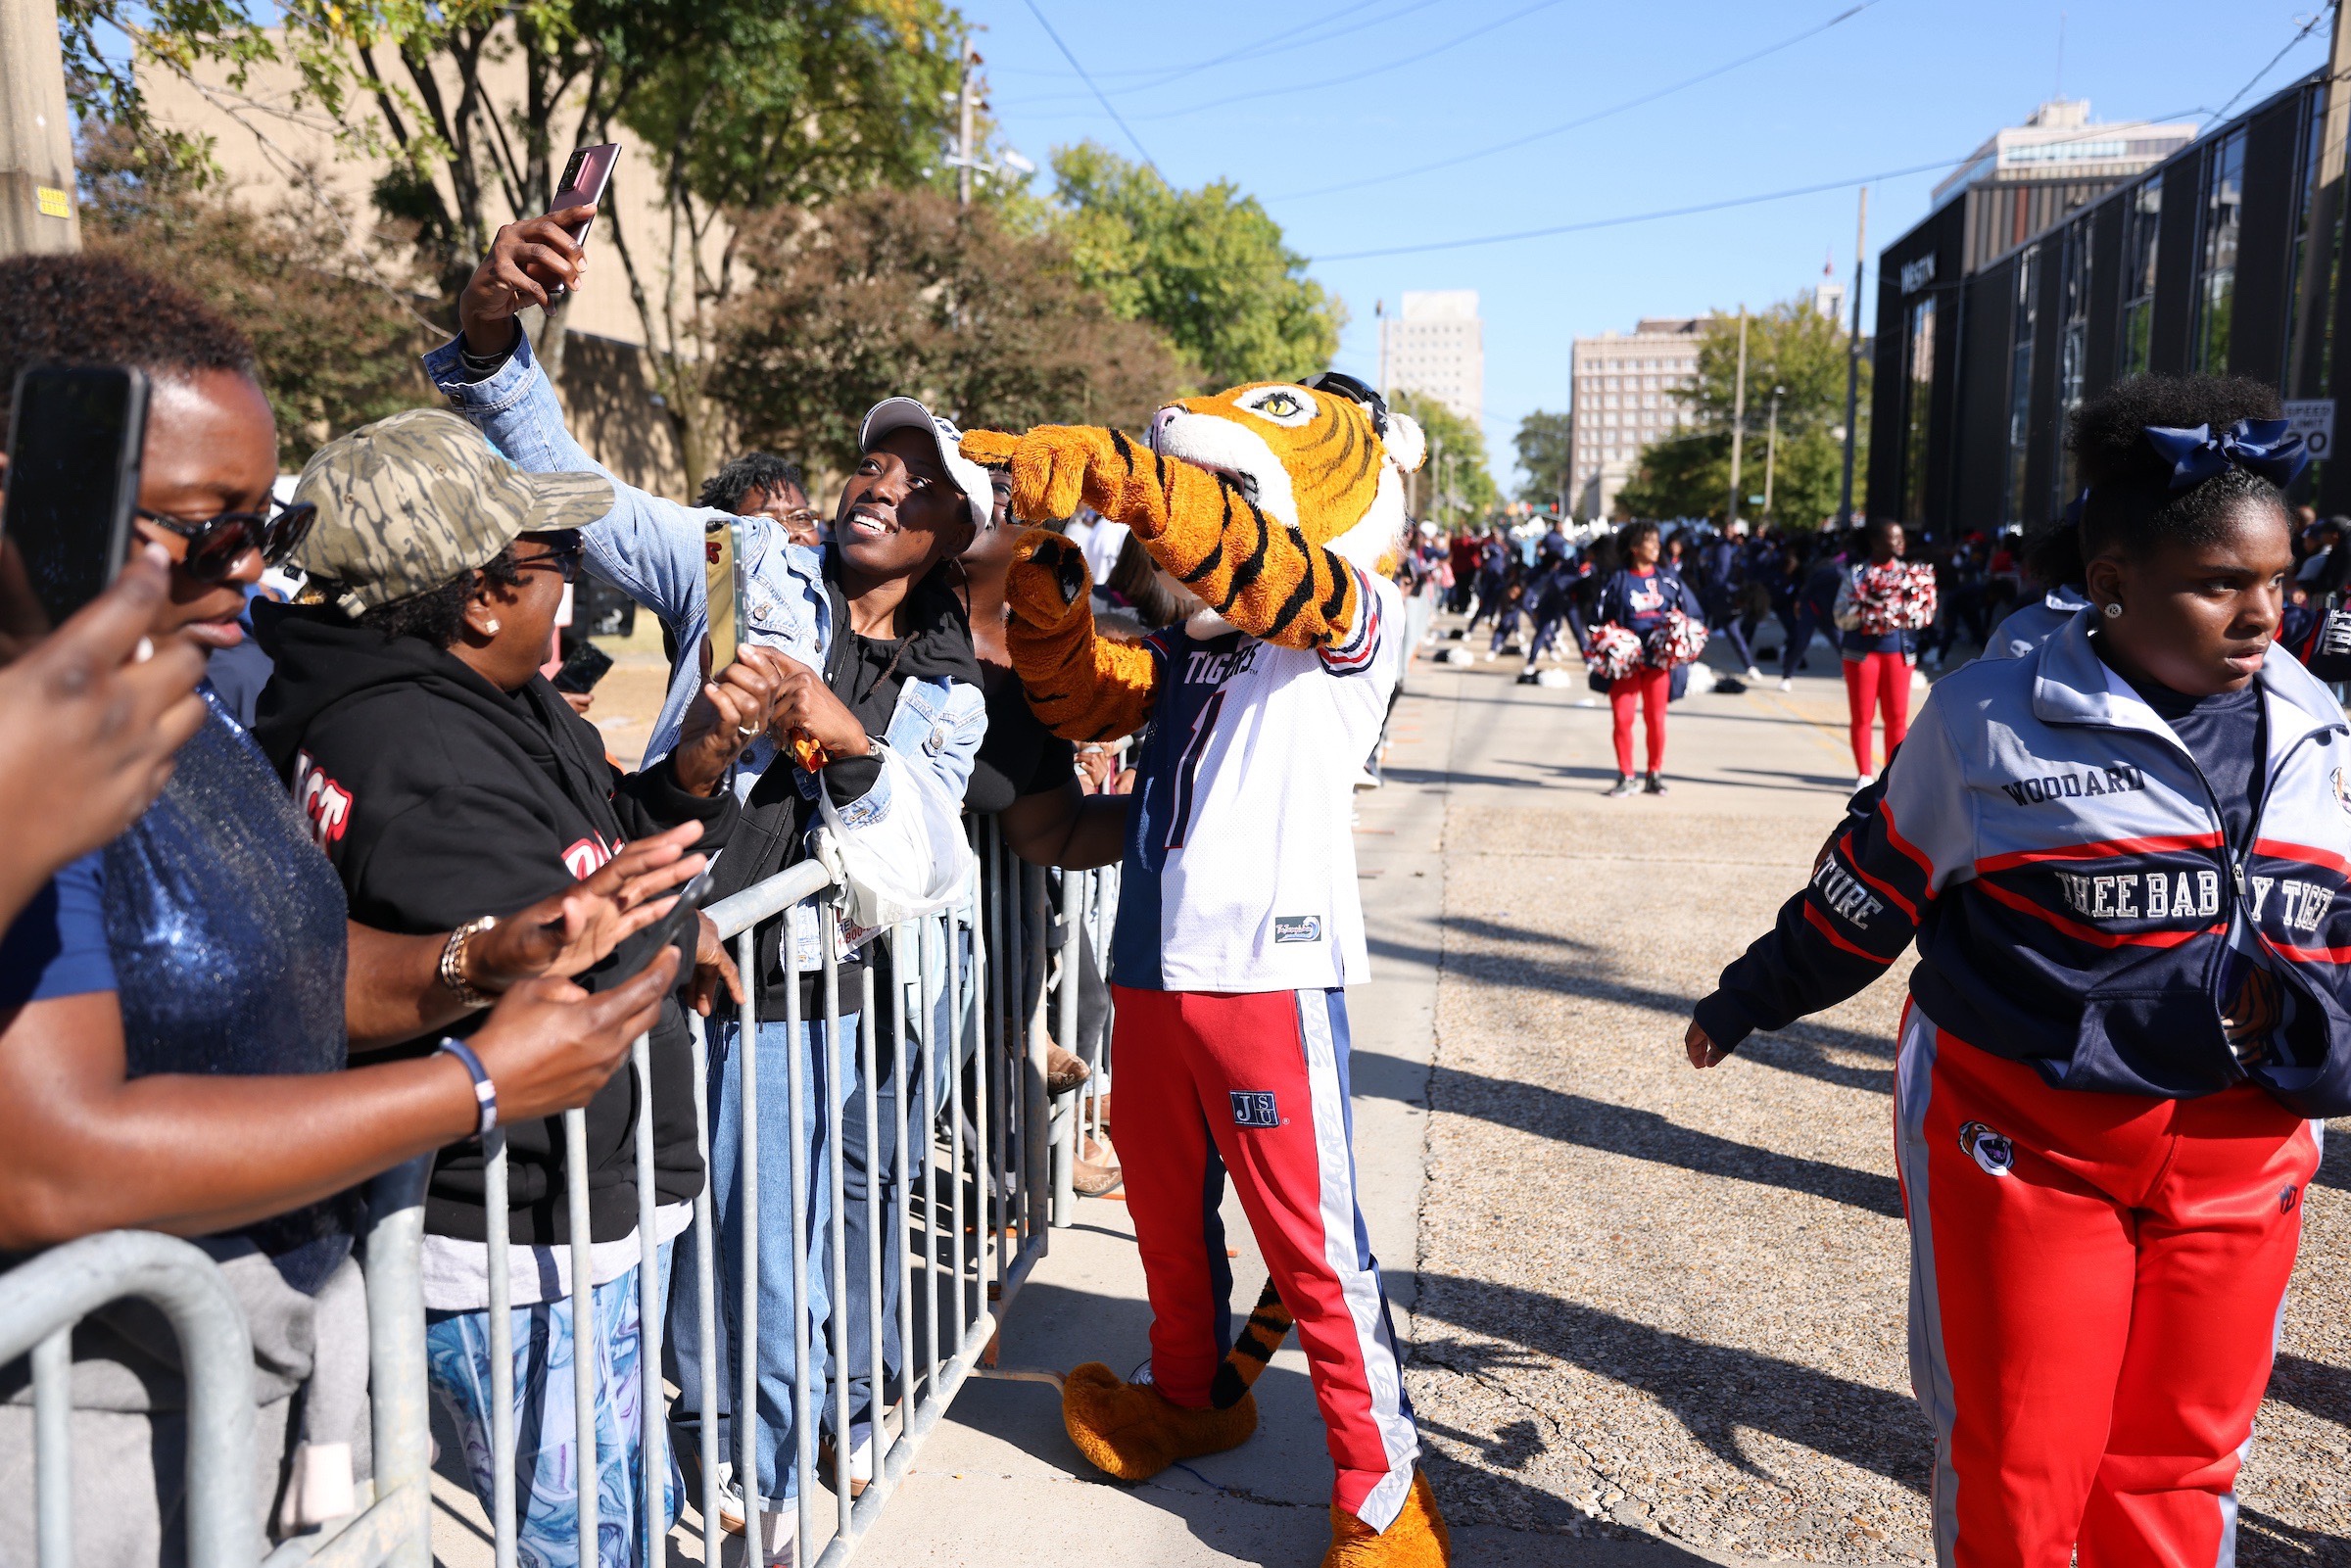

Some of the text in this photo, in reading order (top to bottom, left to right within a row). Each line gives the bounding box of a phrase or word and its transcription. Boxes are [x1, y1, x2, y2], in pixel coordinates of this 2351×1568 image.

[2001, 766, 2145, 806] WOODARD
[1813, 849, 1884, 930] TURE
[2054, 872, 2138, 918] THEE
